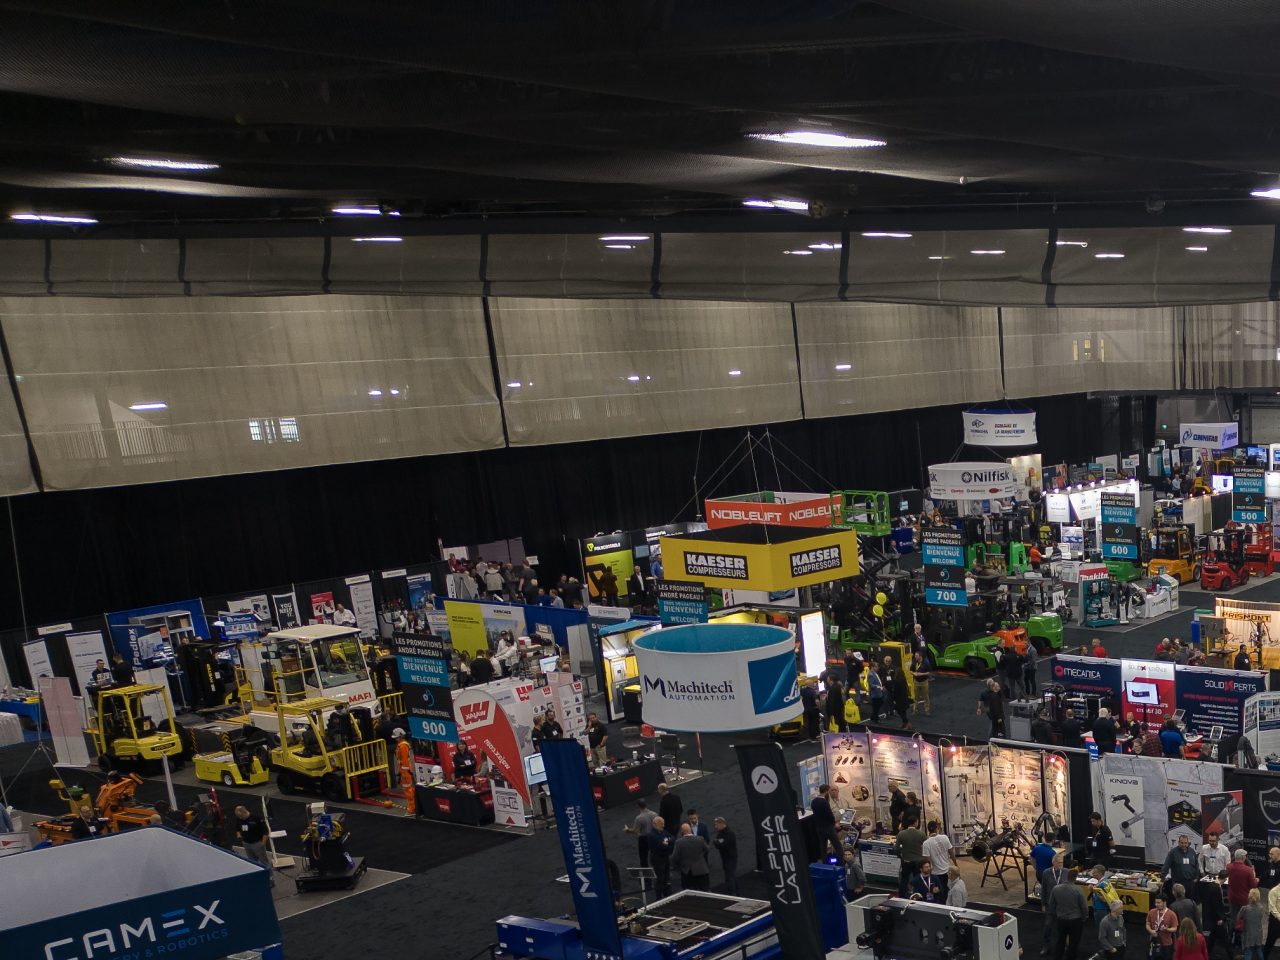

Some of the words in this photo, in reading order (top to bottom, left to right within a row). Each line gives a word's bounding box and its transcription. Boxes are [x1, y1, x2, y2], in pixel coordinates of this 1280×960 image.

[973, 470, 1010, 483] Nilfisk
[711, 509, 782, 522] NOBLELIFT
[1241, 512, 1258, 520] 500
[791, 546, 840, 566] KAESER
[1111, 546, 1128, 554] 600
[686, 553, 745, 569] KAESER
[793, 558, 841, 576] COMPRESSORS
[688, 565, 747, 578] COMPRESSEURS
[669, 585, 705, 593] PROMOTIONS
[679, 593, 701, 601] PAGEAU
[936, 590, 957, 601] 700
[664, 605, 703, 614] BIENVENUE
[1221, 611, 1271, 623] PRISMONT
[406, 638, 443, 649] PROMOTIONS
[398, 646, 417, 655] ANDRÉ
[417, 648, 440, 657] PAGEAU
[403, 662, 444, 674] BIENVENUE
[1064, 667, 1102, 679] MECANICA
[410, 674, 441, 685] WELCOME
[667, 679, 734, 694] Machitech
[349, 692, 372, 703] MAFI
[422, 721, 446, 736] 900
[570, 805, 585, 865] Machitech
[576, 804, 592, 865] AUTOMATION
[760, 815, 789, 905] ALPHA
[774, 814, 801, 904] LAZER
[145, 948, 154, 958] &
[156, 927, 229, 956] ROBOTICS
